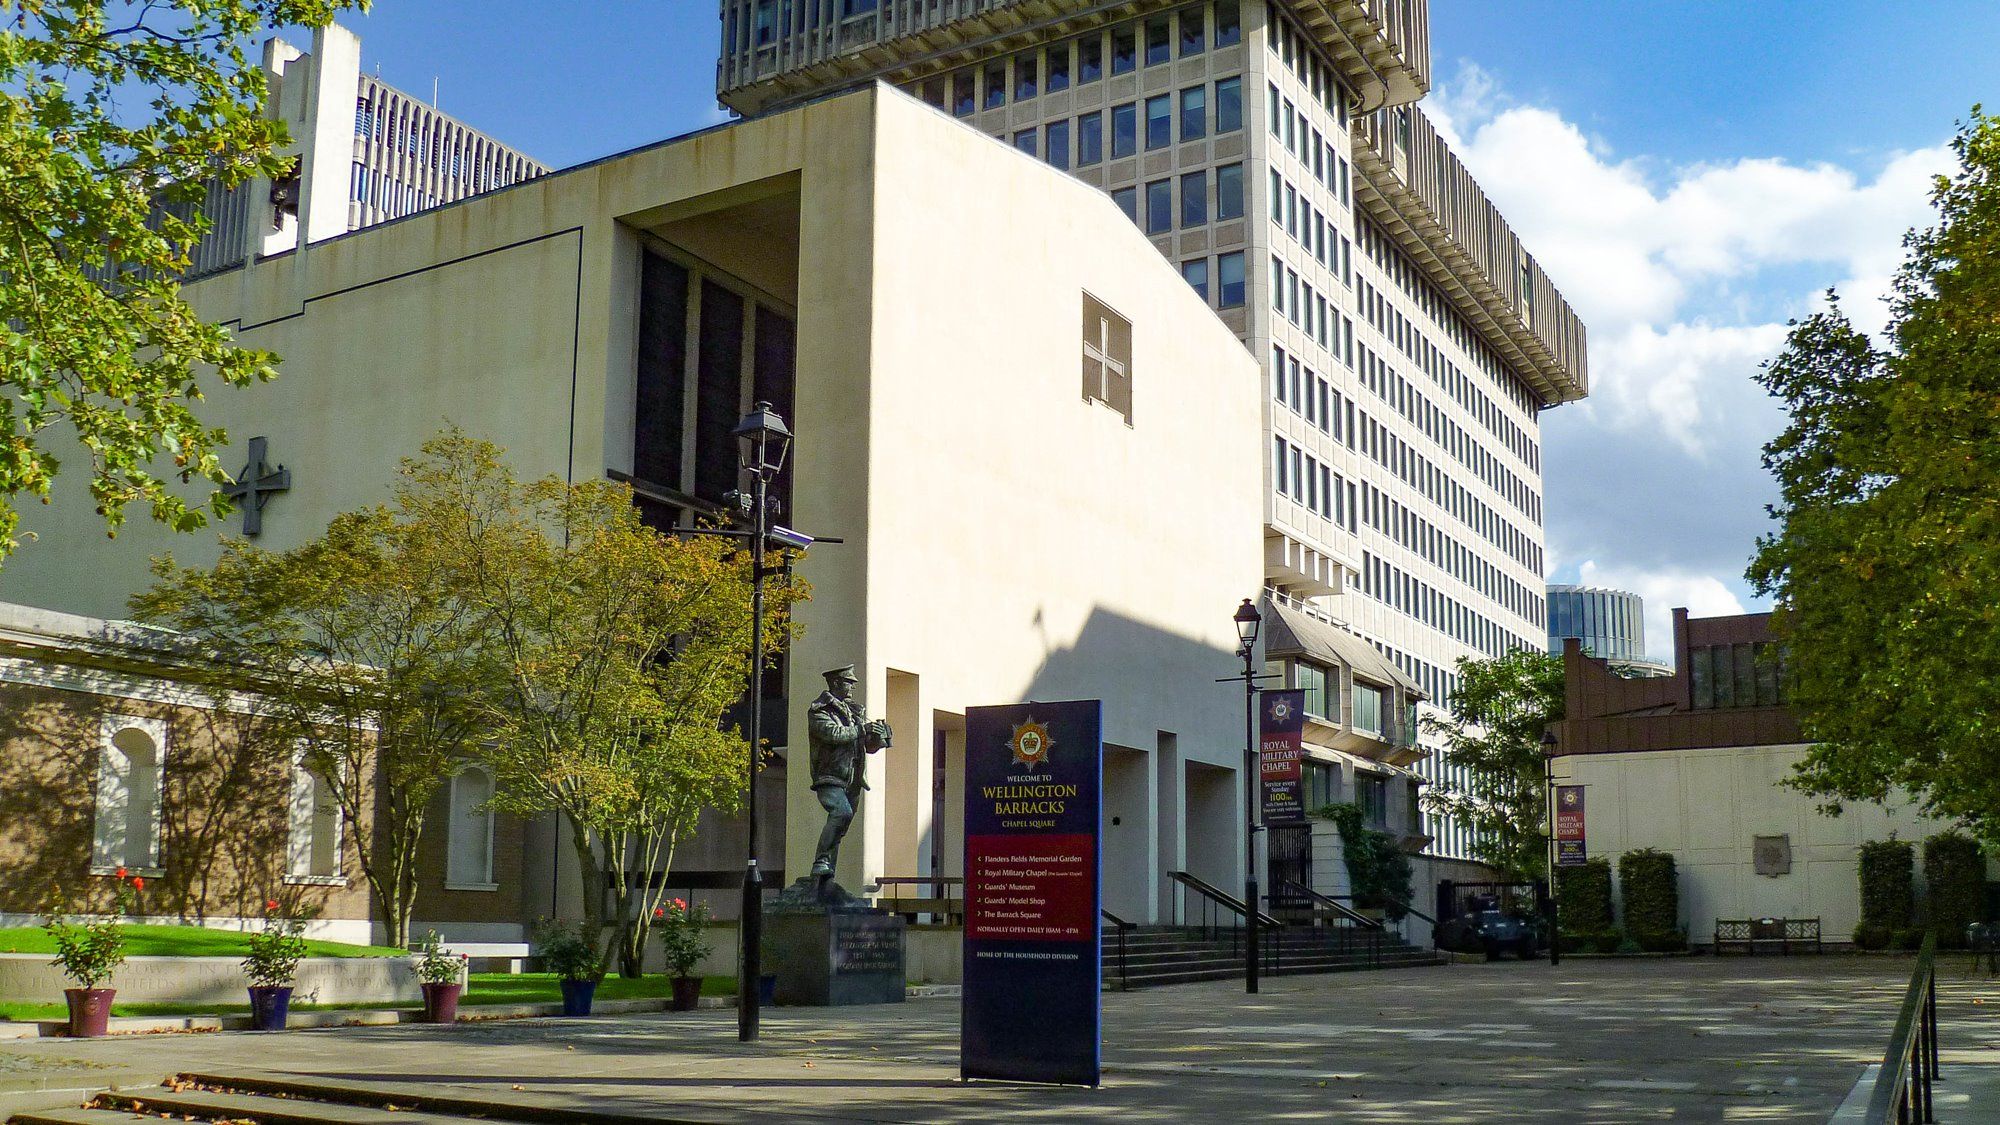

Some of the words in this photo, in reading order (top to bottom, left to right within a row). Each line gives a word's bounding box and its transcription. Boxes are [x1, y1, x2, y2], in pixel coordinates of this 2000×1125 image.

[1263, 741, 1290, 751] ROYAL
[1262, 751, 1298, 761] MILITARY
[1261, 762, 1291, 771] CHAPEL
[982, 785, 1077, 799] WELLINGTON
[995, 801, 1064, 814] BARRACKS
[1029, 820, 1056, 828] SQUARE
[984, 870, 1001, 878] Royal
[1002, 870, 1025, 878] Military
[1026, 869, 1047, 878] Chapel
[1029, 898, 1046, 906] Shop
[124, 978, 178, 990] FIELDS
